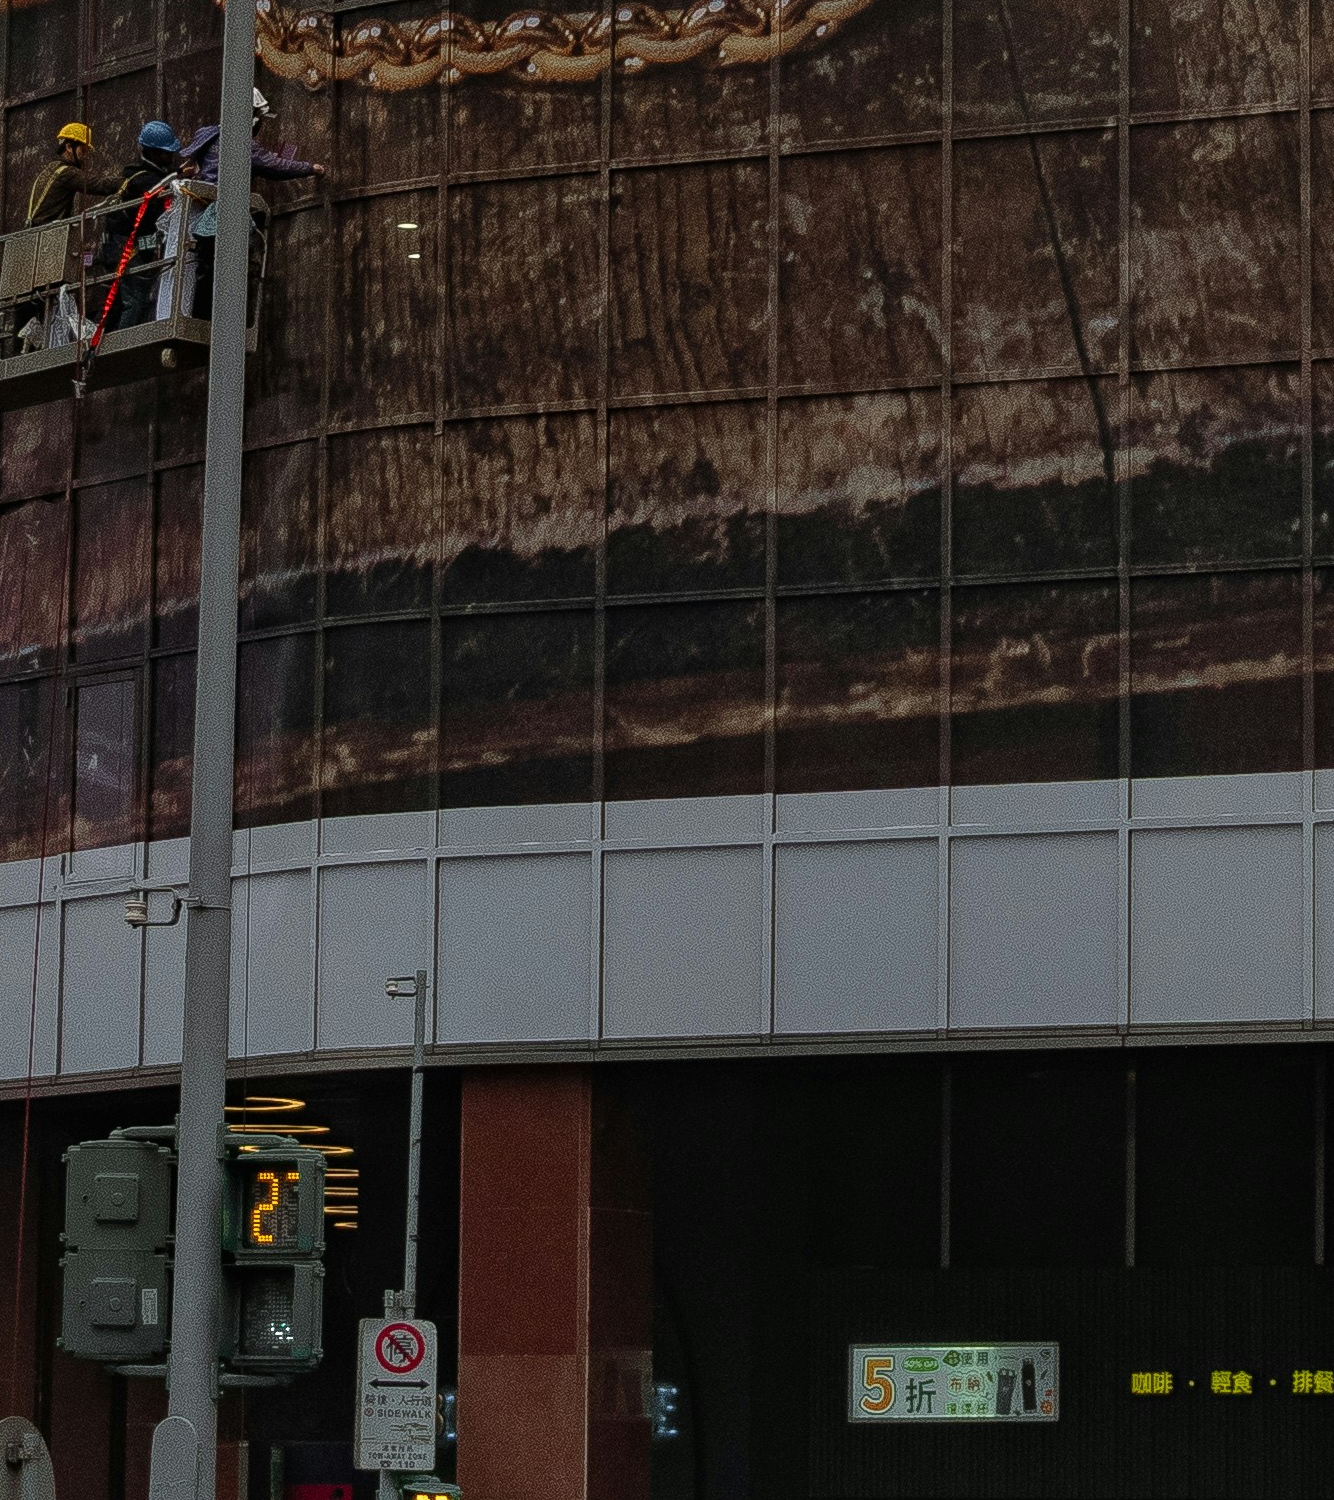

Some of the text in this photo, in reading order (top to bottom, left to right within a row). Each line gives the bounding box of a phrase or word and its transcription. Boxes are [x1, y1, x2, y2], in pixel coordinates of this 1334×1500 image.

[253, 1171, 300, 1244] 2
[1130, 1369, 1334, 1395] 咖啡 輕食 排餐
[906, 1378, 937, 1414] 折
[377, 1408, 432, 1419] SIDEWALK
[398, 1460, 416, 1468] 110
